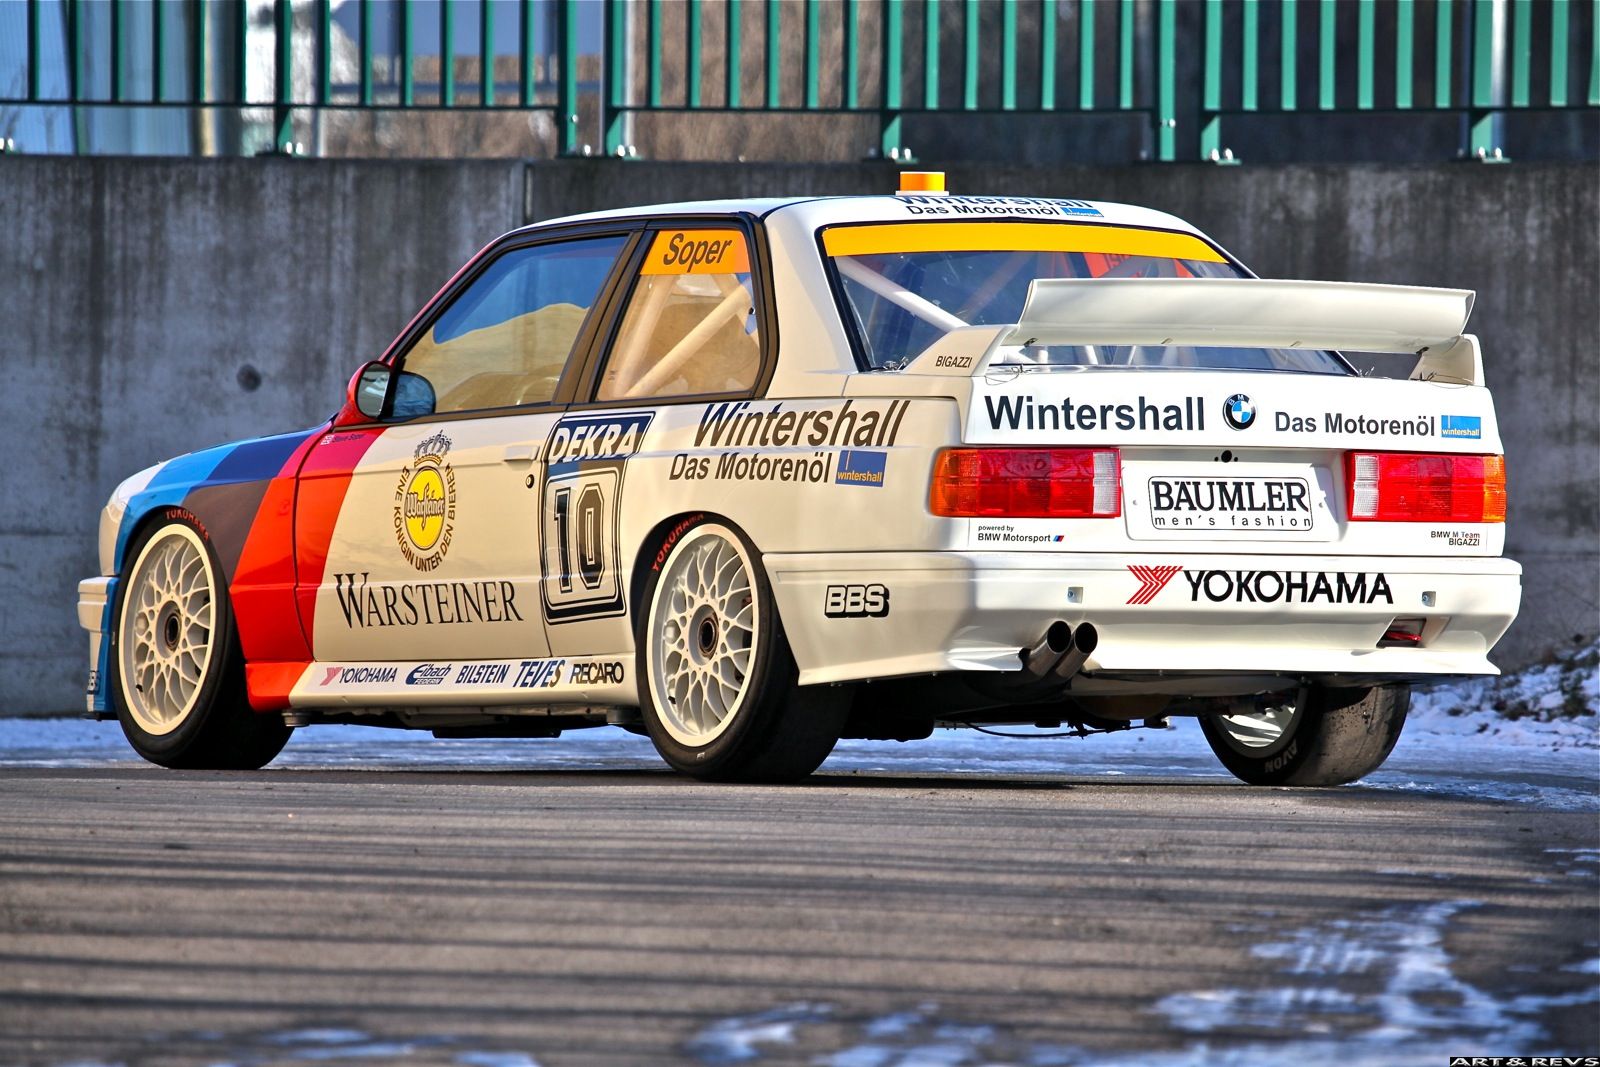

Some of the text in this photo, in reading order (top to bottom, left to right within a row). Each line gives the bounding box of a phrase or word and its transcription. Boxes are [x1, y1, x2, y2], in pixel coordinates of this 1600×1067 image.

[906, 205, 1060, 216] Das Motorenöl
[663, 233, 733, 273] Soper
[935, 355, 973, 368] BIGAZZI
[694, 399, 911, 448] Wintershall
[984, 395, 1205, 431] Wintershall
[1274, 411, 1435, 437] Das Motorenöl
[548, 422, 640, 466] DEKRA
[1441, 428, 1480, 437] wintershall
[669, 451, 833, 483] Das Motorenöl
[837, 470, 883, 482] wintershall
[395, 465, 411, 502] EINE
[1152, 481, 1309, 513] BÄUMLER
[1231, 515, 1311, 527] fashion
[1430, 530, 1480, 539] BMW M Team
[394, 506, 415, 566] KÖNIGIN
[440, 523, 455, 557] DEN
[554, 483, 606, 593] 10
[977, 533, 1051, 543] BMW Motorsport
[1448, 537, 1480, 546] BIGAZZI
[414, 554, 443, 574] UNTER
[1182, 570, 1393, 604] YOKOHAMA
[824, 584, 890, 618] BBS
[339, 667, 398, 684] YOKOHAMA
[405, 663, 452, 685] Eibach
[455, 664, 511, 684] BILSTEIN
[512, 660, 565, 688] TEVES
[569, 662, 625, 684] RECARO
[1264, 738, 1297, 773] AVON
